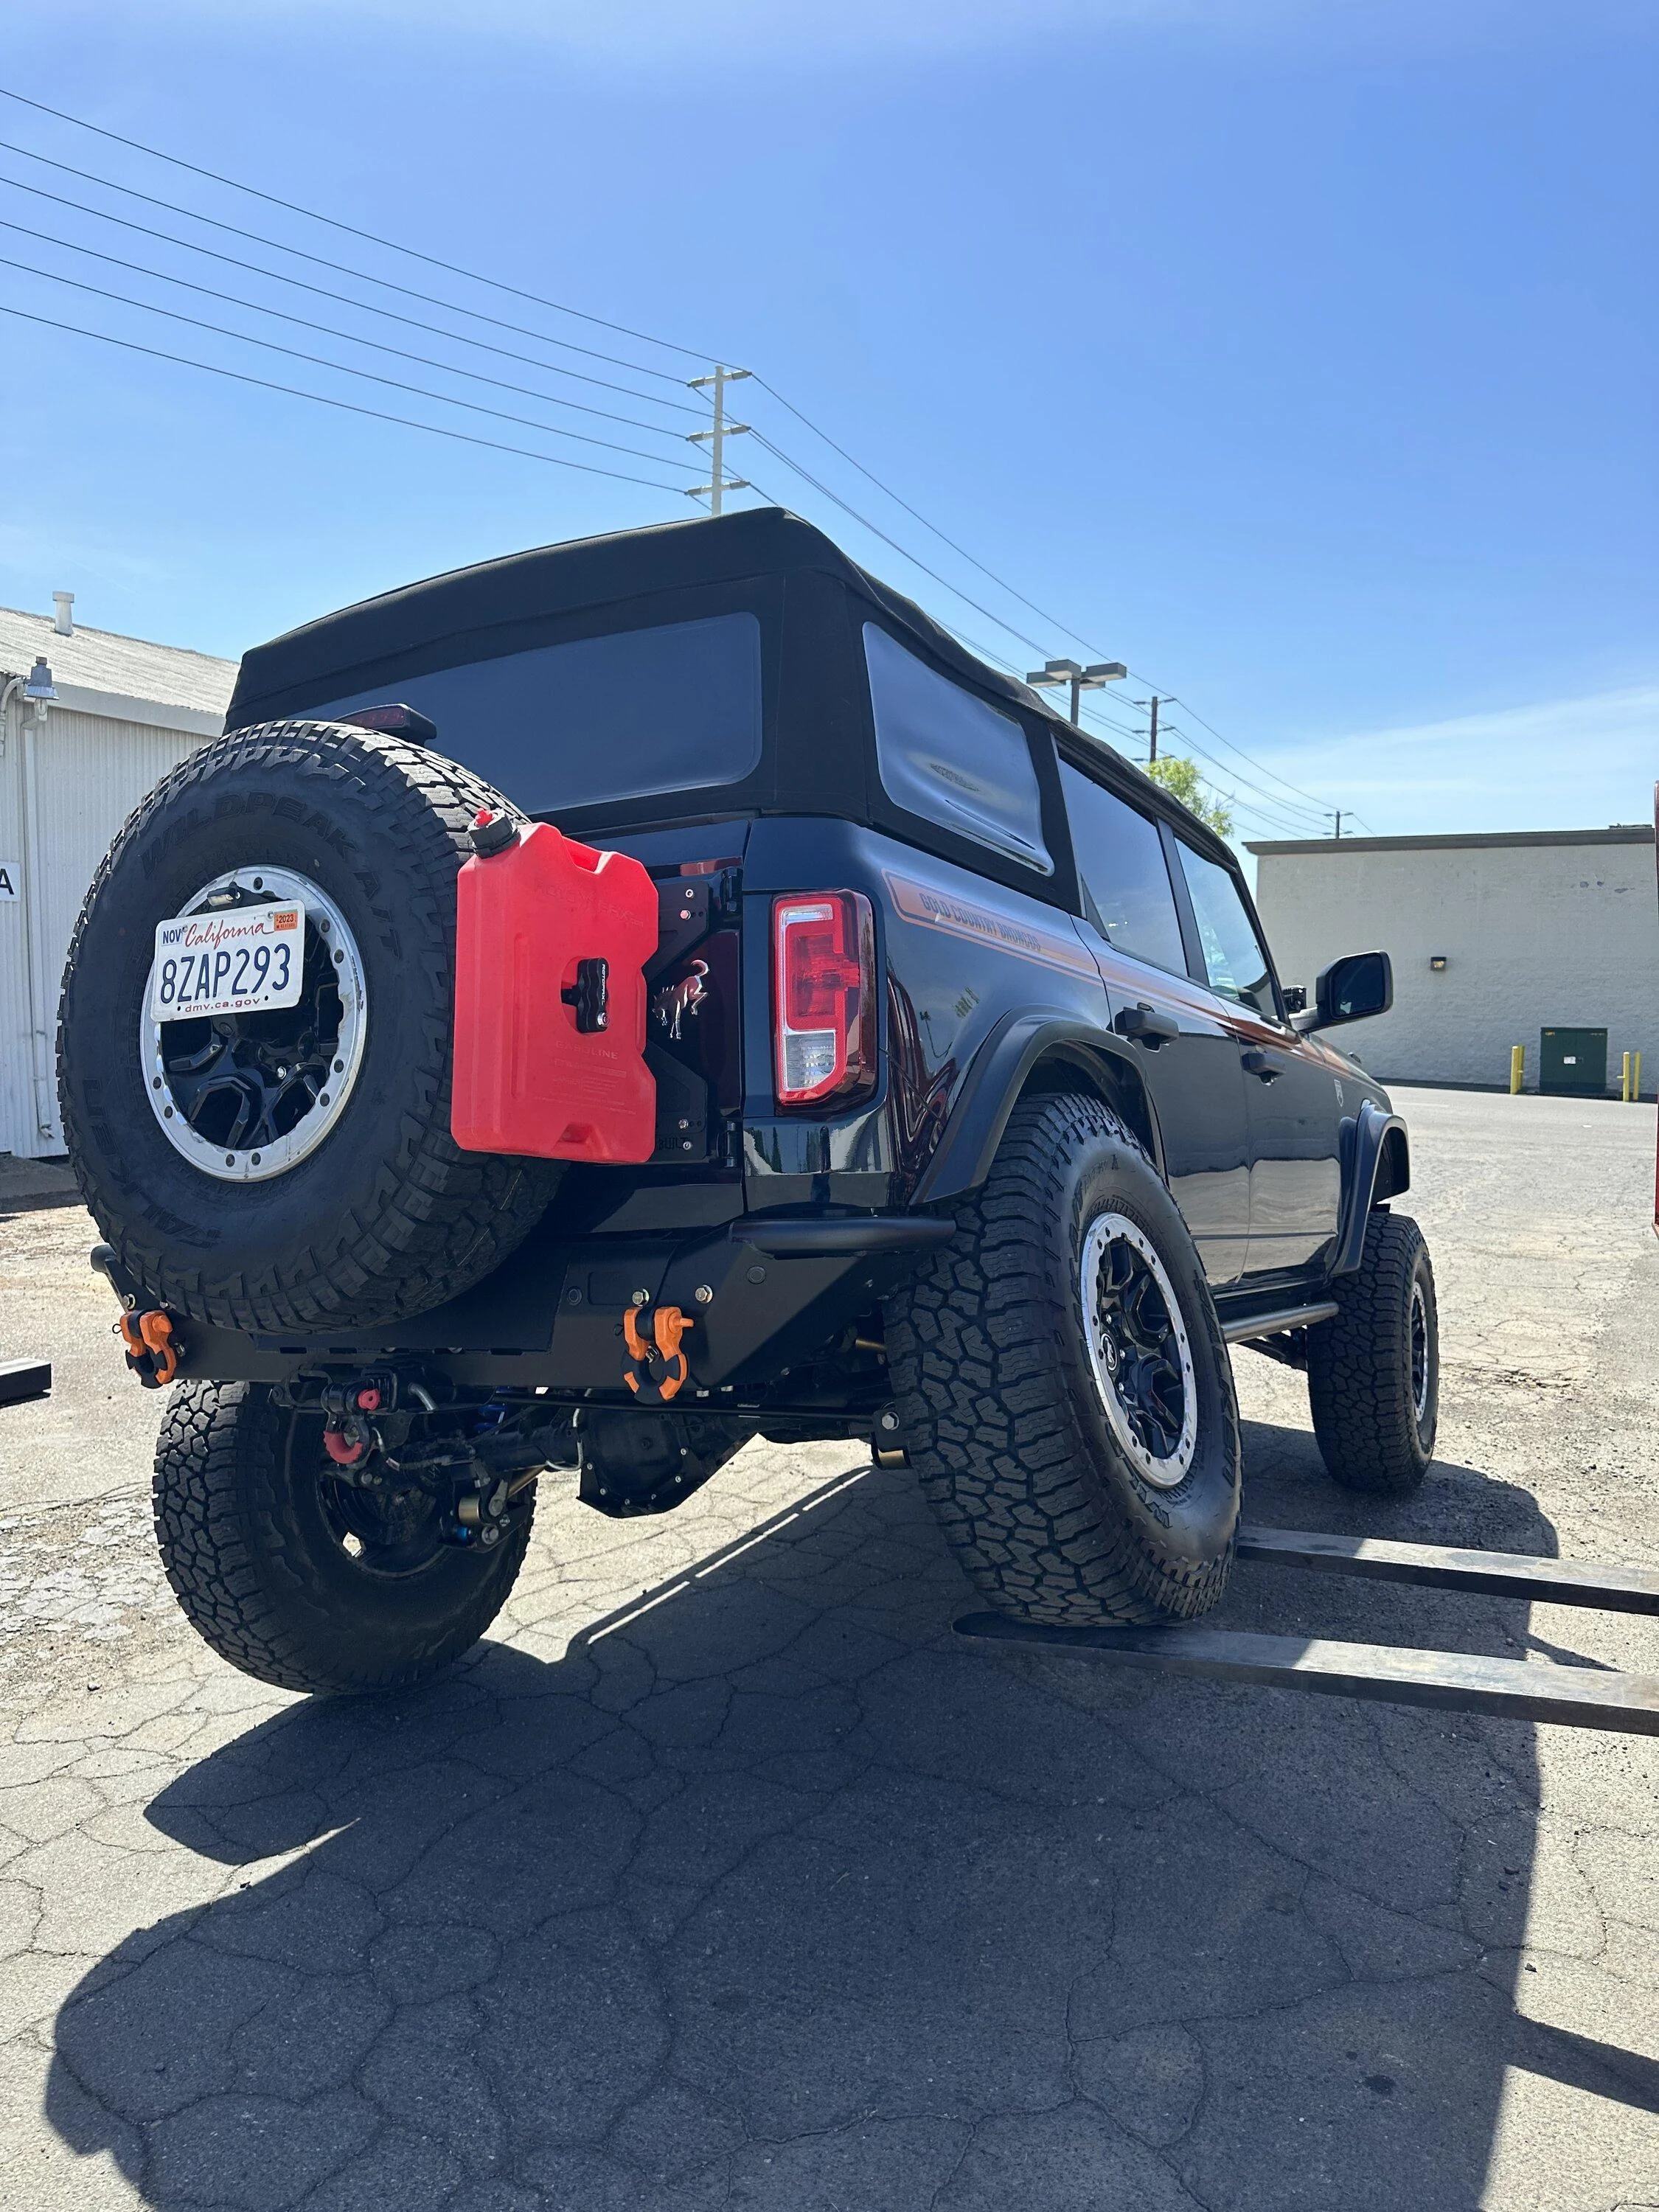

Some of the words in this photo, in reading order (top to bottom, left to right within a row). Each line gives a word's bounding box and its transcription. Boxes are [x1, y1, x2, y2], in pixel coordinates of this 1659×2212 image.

[0, 869, 14, 895] A
[278, 914, 294, 924] 2023
[919, 893, 951, 918] GOLD
[951, 908, 996, 935] COUNTRY
[163, 930, 181, 945] NOV
[185, 919, 275, 950] California
[160, 943, 291, 1004] 8ZAP293
[185, 998, 260, 1013] dmv.ca.gov
[555, 1040, 619, 1060] GASOLINE
